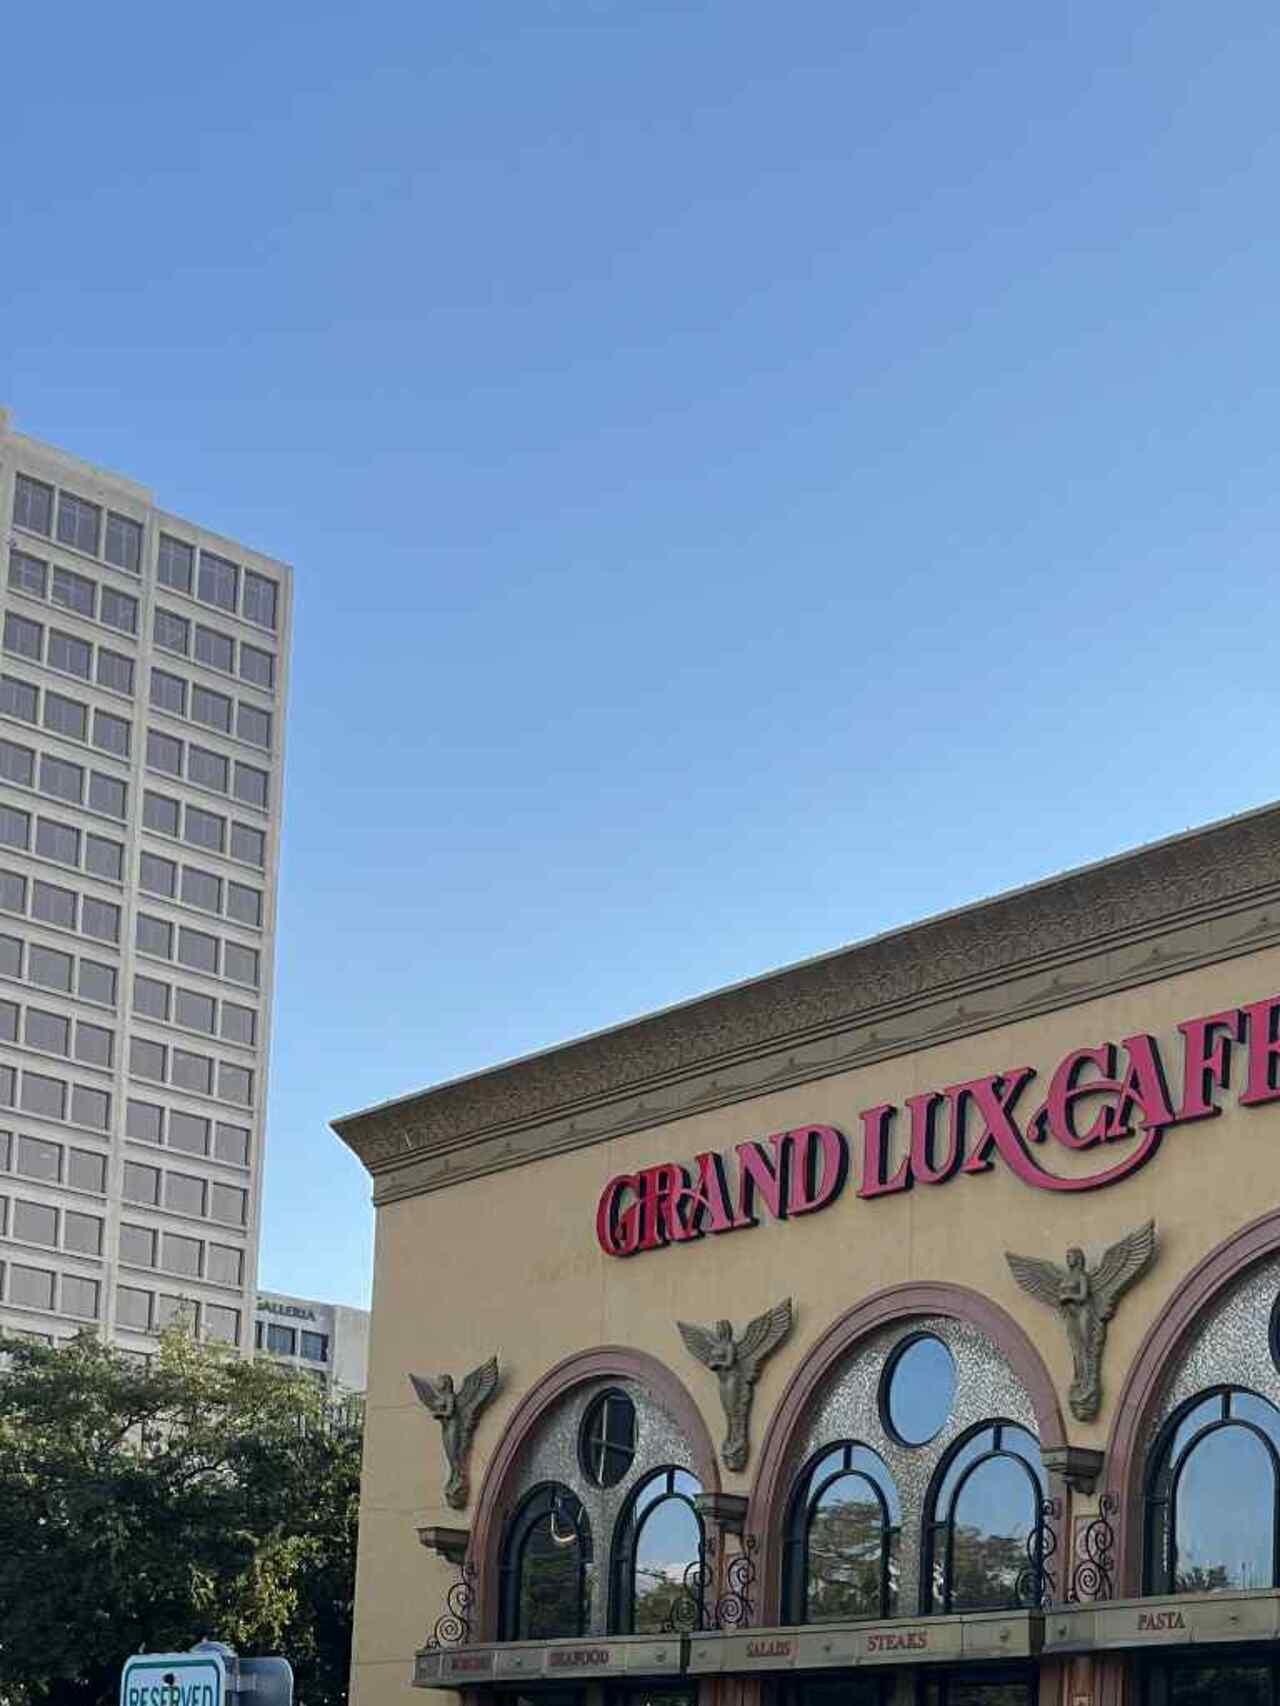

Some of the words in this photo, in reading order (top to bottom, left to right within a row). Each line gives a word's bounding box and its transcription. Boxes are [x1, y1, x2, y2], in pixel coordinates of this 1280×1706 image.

[597, 1122, 849, 1257] GRAND
[857, 1066, 1165, 1199] LUX
[1137, 1611, 1186, 1632] PASTA
[745, 1639, 793, 1658] SALADS
[866, 1630, 928, 1653] STEAKS
